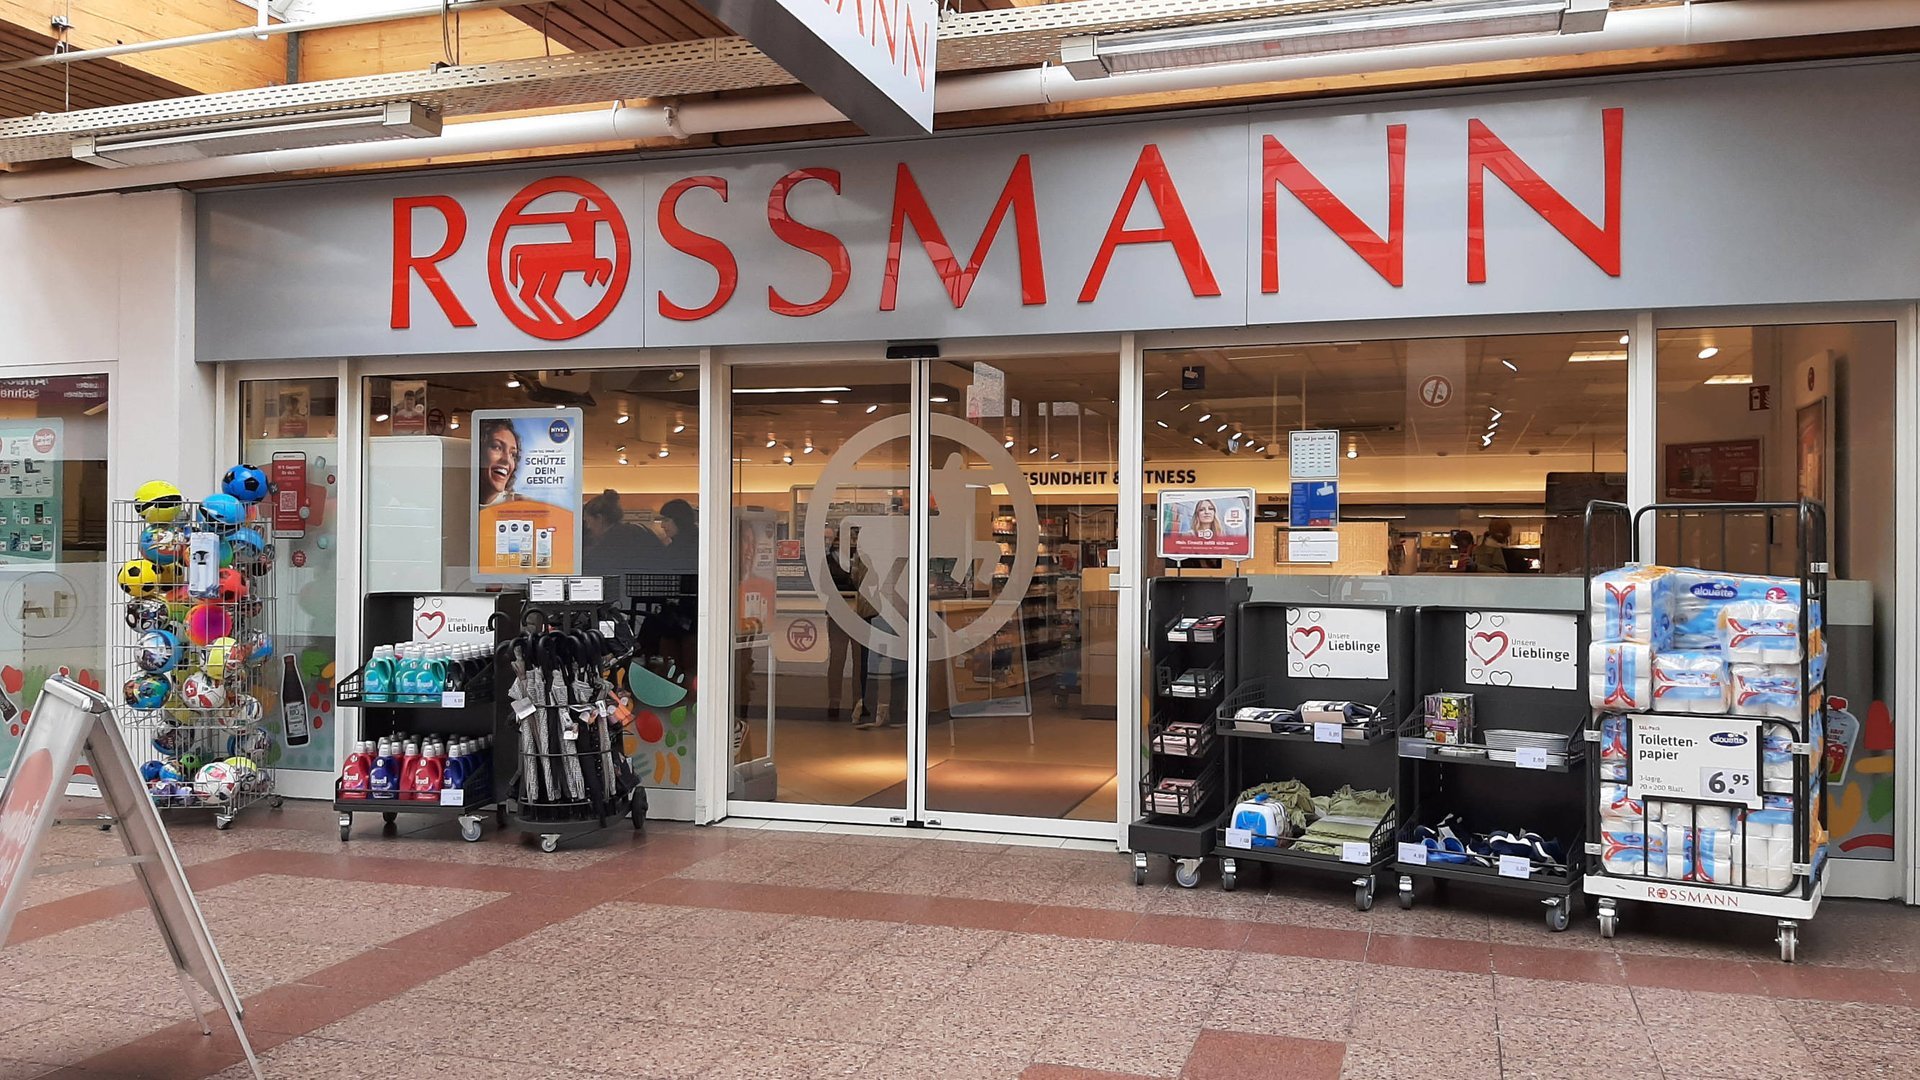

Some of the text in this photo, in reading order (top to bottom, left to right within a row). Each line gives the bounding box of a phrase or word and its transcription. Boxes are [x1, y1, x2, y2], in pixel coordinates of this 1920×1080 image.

[390, 107, 1624, 341] ROSSMANN
[525, 455, 566, 466] SCHÜTZE
[535, 467, 556, 475] DEIN
[1022, 471, 1107, 486] SUNDHEIT
[1144, 469, 1196, 484] TNESS
[526, 476, 564, 485] GESICHT
[1694, 586, 1734, 598] alouette
[1329, 640, 1381, 653] Lieblinge
[1512, 647, 1570, 662] Lieblinge
[1639, 734, 1698, 747] Toiletten-
[1712, 735, 1744, 744] alouette
[1639, 749, 1679, 761] papier
[1708, 771, 1750, 795] 6.95
[1647, 886, 1739, 907] ROSSMANN
